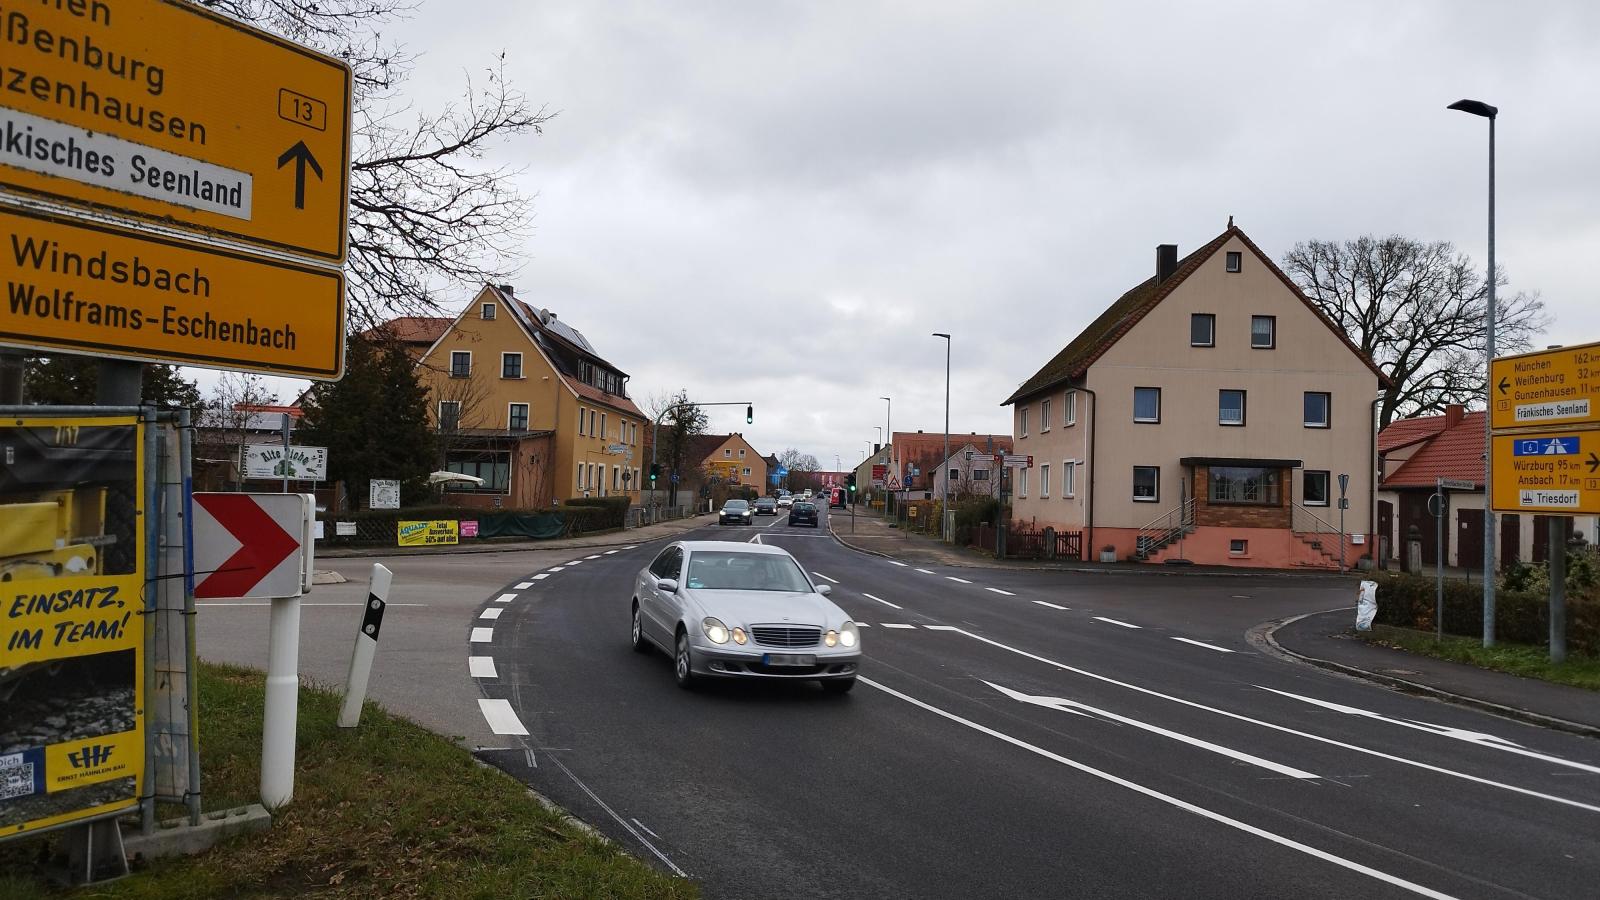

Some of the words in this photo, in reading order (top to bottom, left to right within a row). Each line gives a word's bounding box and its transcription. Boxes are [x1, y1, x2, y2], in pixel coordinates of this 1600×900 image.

[0, 8, 164, 95] ßenburg
[0, 66, 206, 145] zenhausen
[292, 98, 313, 122] 13
[0, 120, 115, 177] kisches
[130, 155, 242, 208] Seenland
[11, 234, 210, 297] Windsbach
[7, 281, 296, 350] Wolframs-Eschenbach
[1514, 360, 1551, 372] München
[1574, 353, 1589, 364] 162
[1515, 373, 1565, 387] Weißenburg
[1577, 368, 1588, 379] 32
[1514, 386, 1576, 400] Gunzenhausen
[1581, 383, 1588, 393] 11
[1517, 406, 1554, 418] Fränkisches
[1556, 403, 1588, 415] Seenland
[260, 449, 281, 463] Alte
[1514, 460, 1554, 472] Würzburg
[1557, 459, 1568, 470] 95
[1569, 462, 1580, 470] km
[1518, 474, 1554, 485] Ansbach
[1559, 474, 1568, 485] 17
[1569, 476, 1580, 485] km
[1537, 492, 1577, 504] Triesdorf
[8, 586, 124, 618] EINSATZ,
[7, 628, 43, 651] IM
[54, 610, 131, 647] TEAM!
[57, 774, 78, 783] ERNST
[113, 764, 126, 772] BAU
